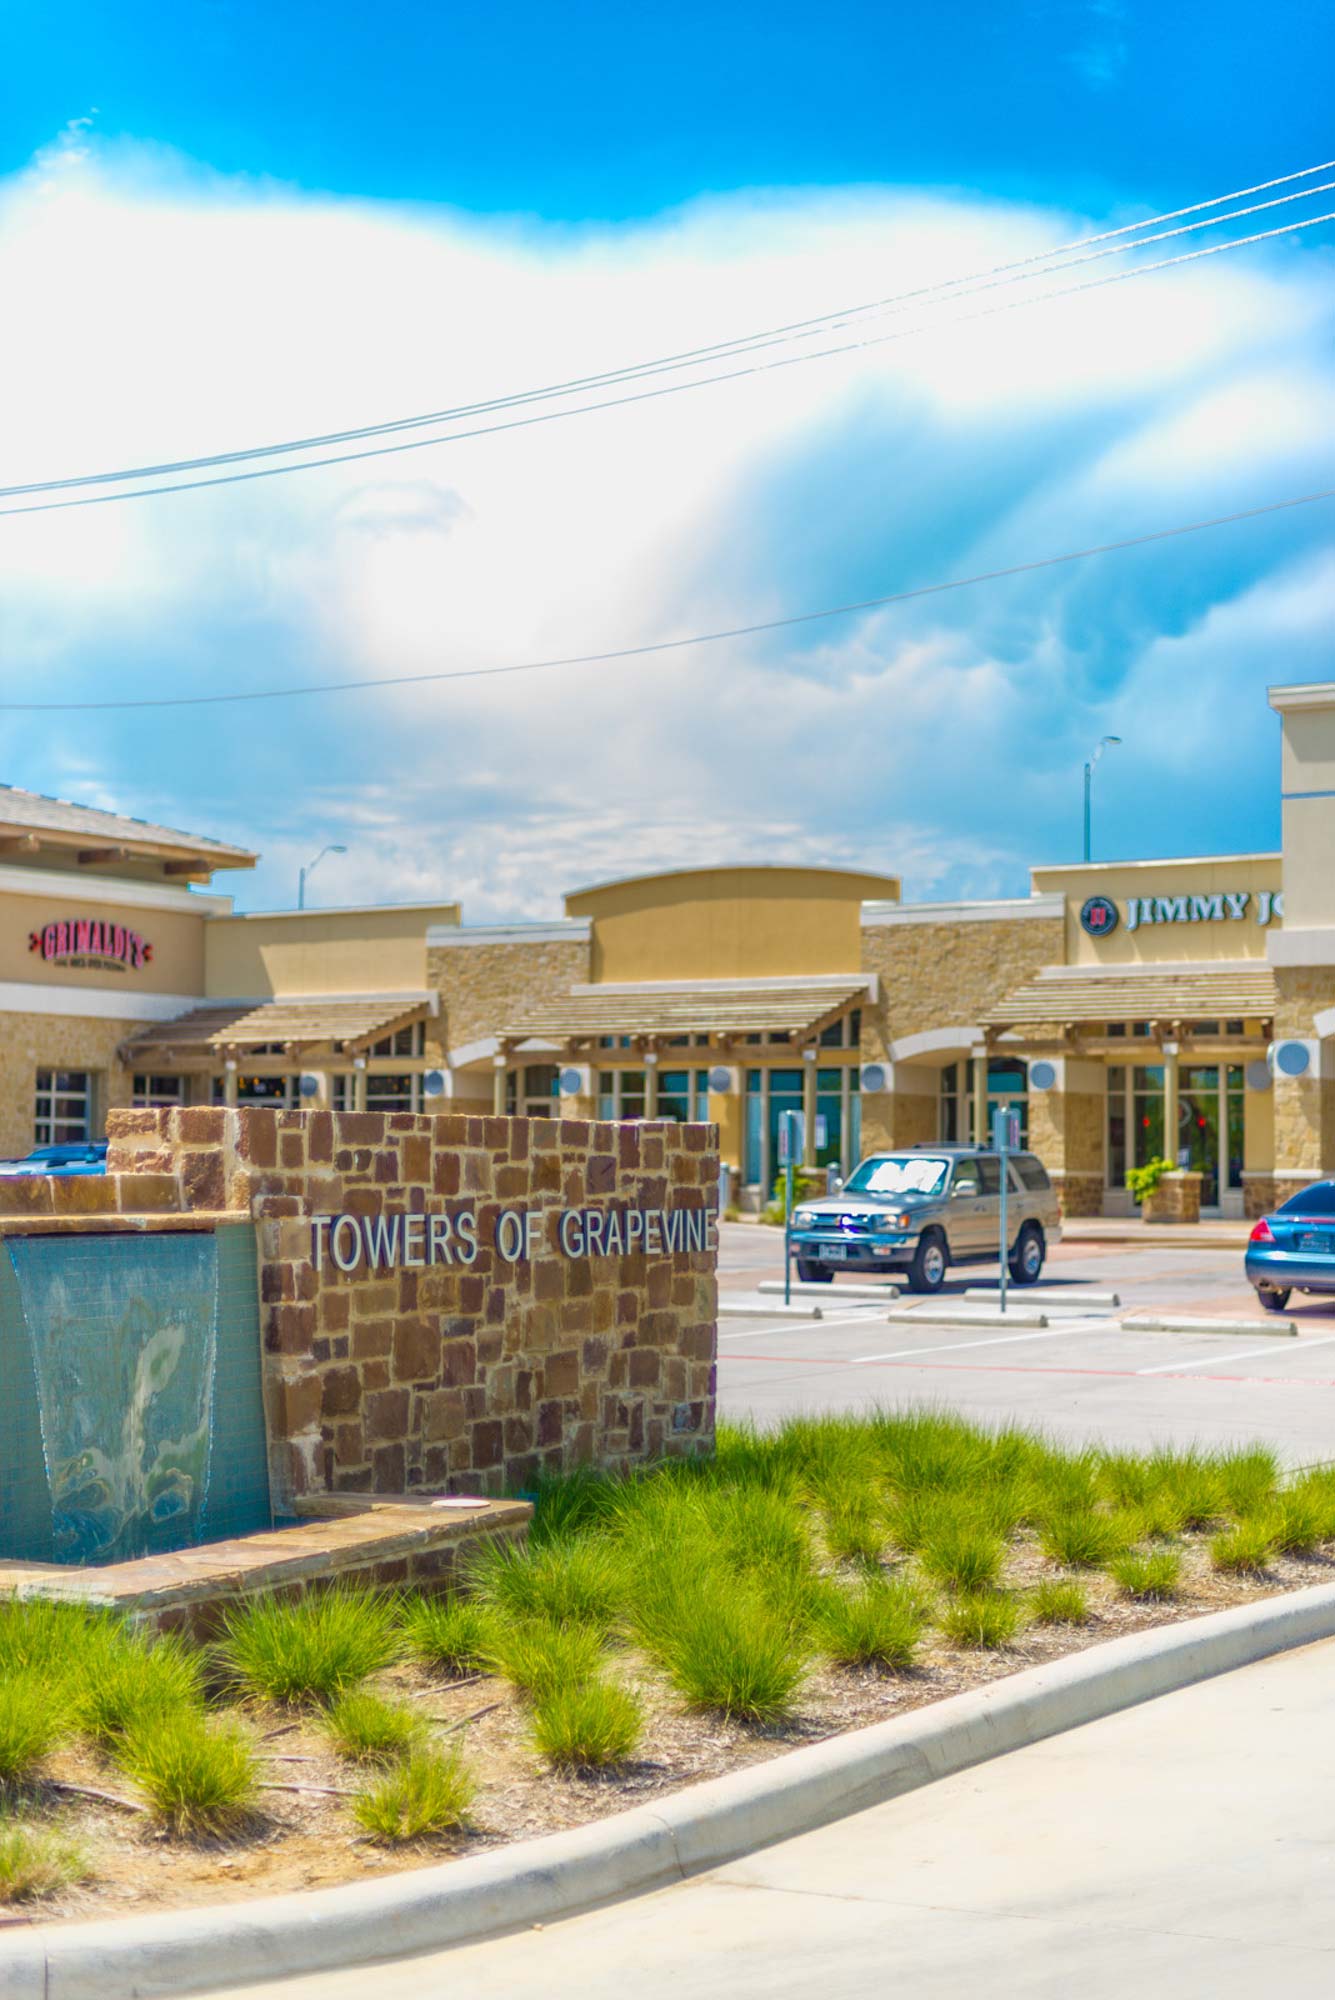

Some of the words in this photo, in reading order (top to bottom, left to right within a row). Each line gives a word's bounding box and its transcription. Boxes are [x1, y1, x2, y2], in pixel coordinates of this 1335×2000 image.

[1125, 892, 1251, 931] JIMMY
[311, 1211, 478, 1272] TOWERS
[495, 1210, 546, 1263] OF
[560, 1208, 719, 1259] GRAPEVINE
